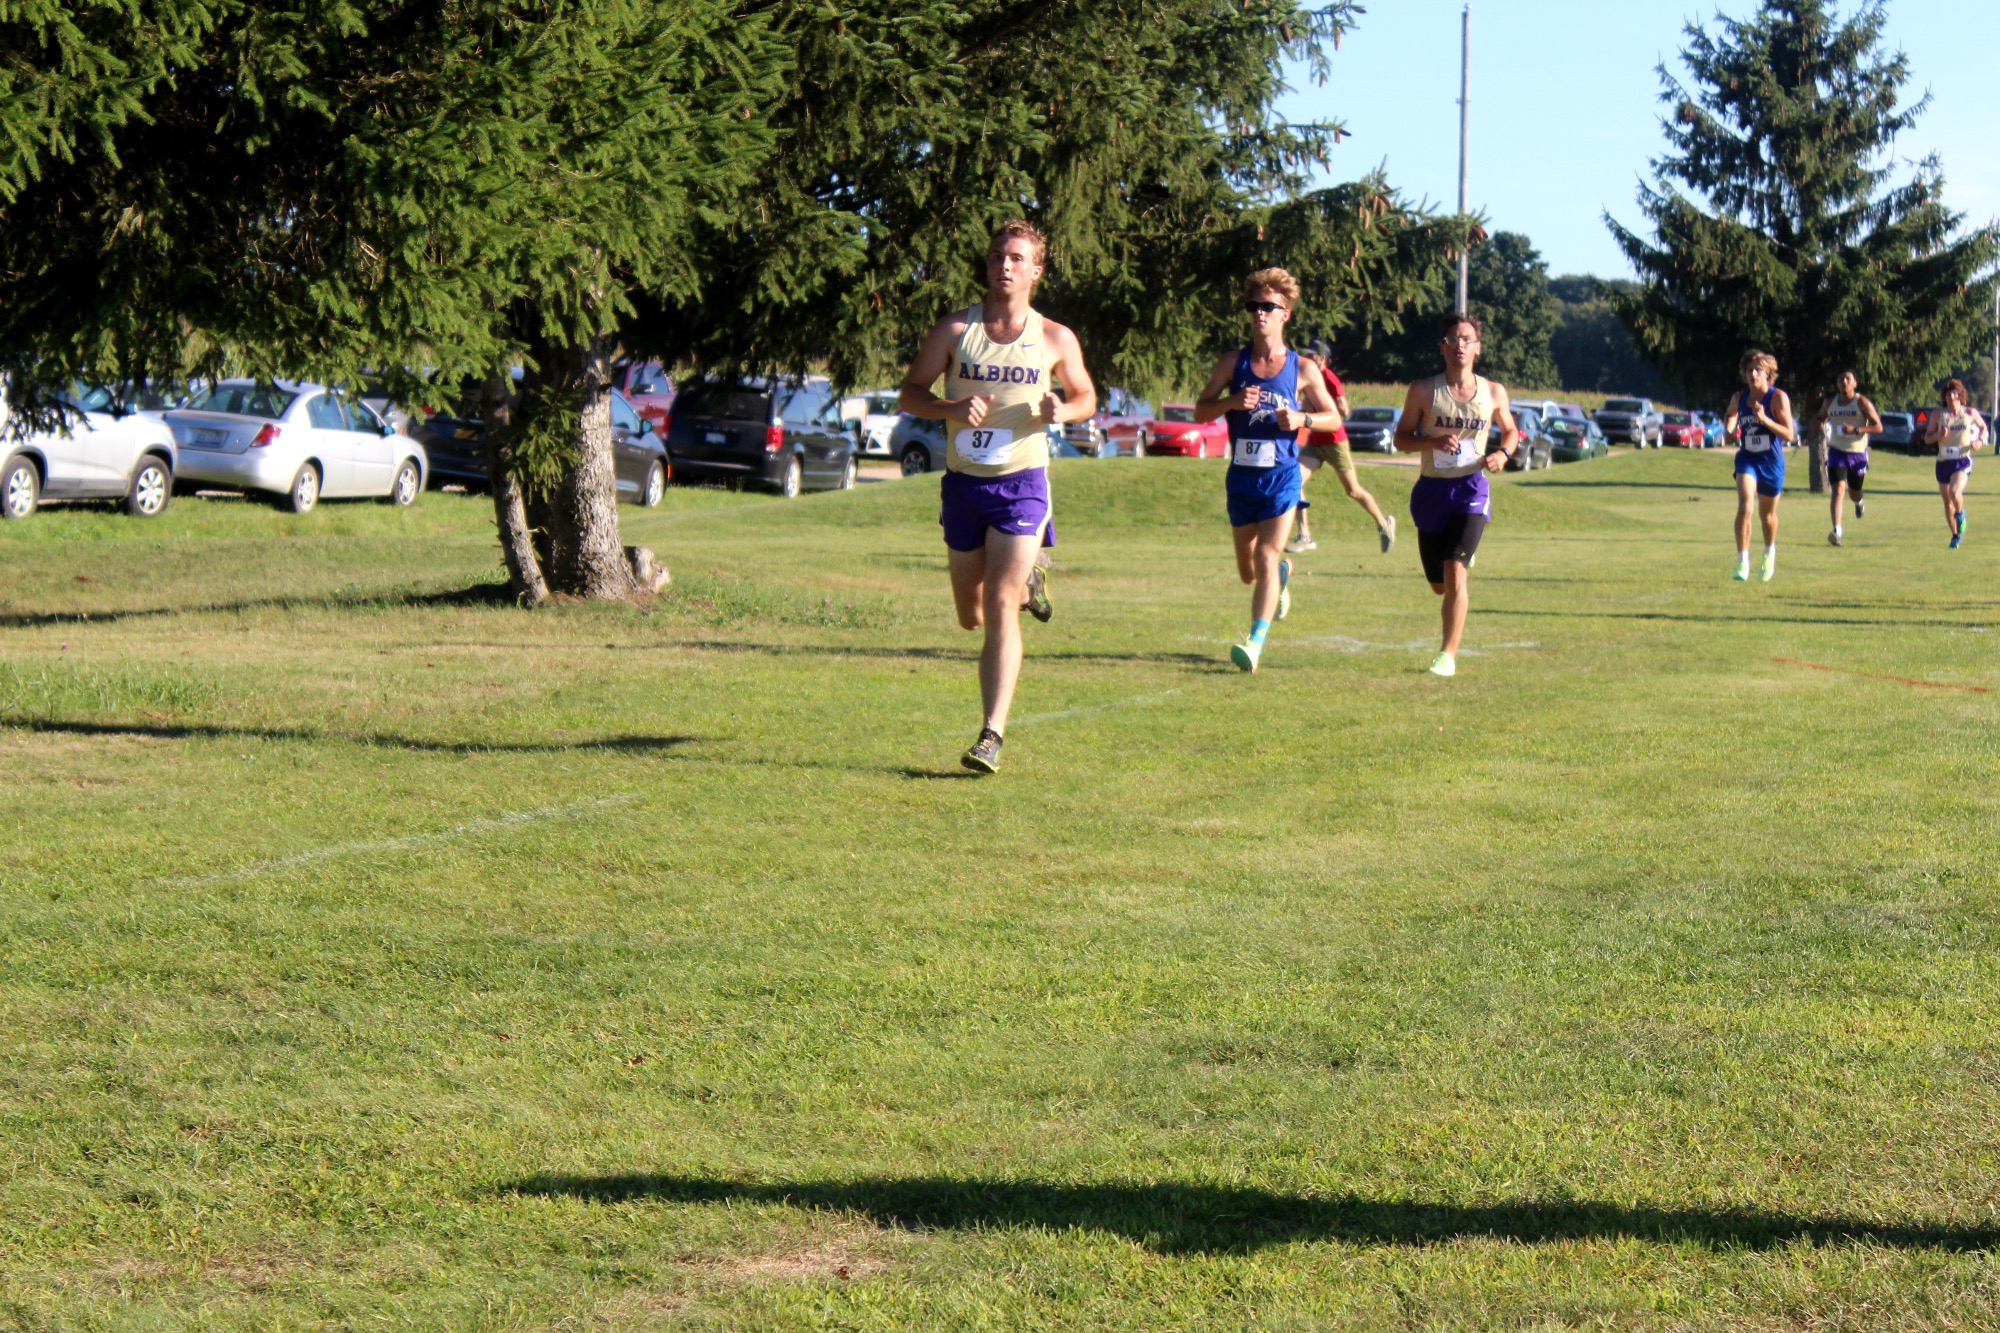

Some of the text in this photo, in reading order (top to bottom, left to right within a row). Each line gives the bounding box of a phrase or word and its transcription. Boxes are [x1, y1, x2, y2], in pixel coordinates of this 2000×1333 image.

[959, 363, 1040, 385] ALBION
[1434, 416, 1487, 430] ALBION
[971, 430, 994, 448] 37
[1245, 442, 1262, 455] 87
